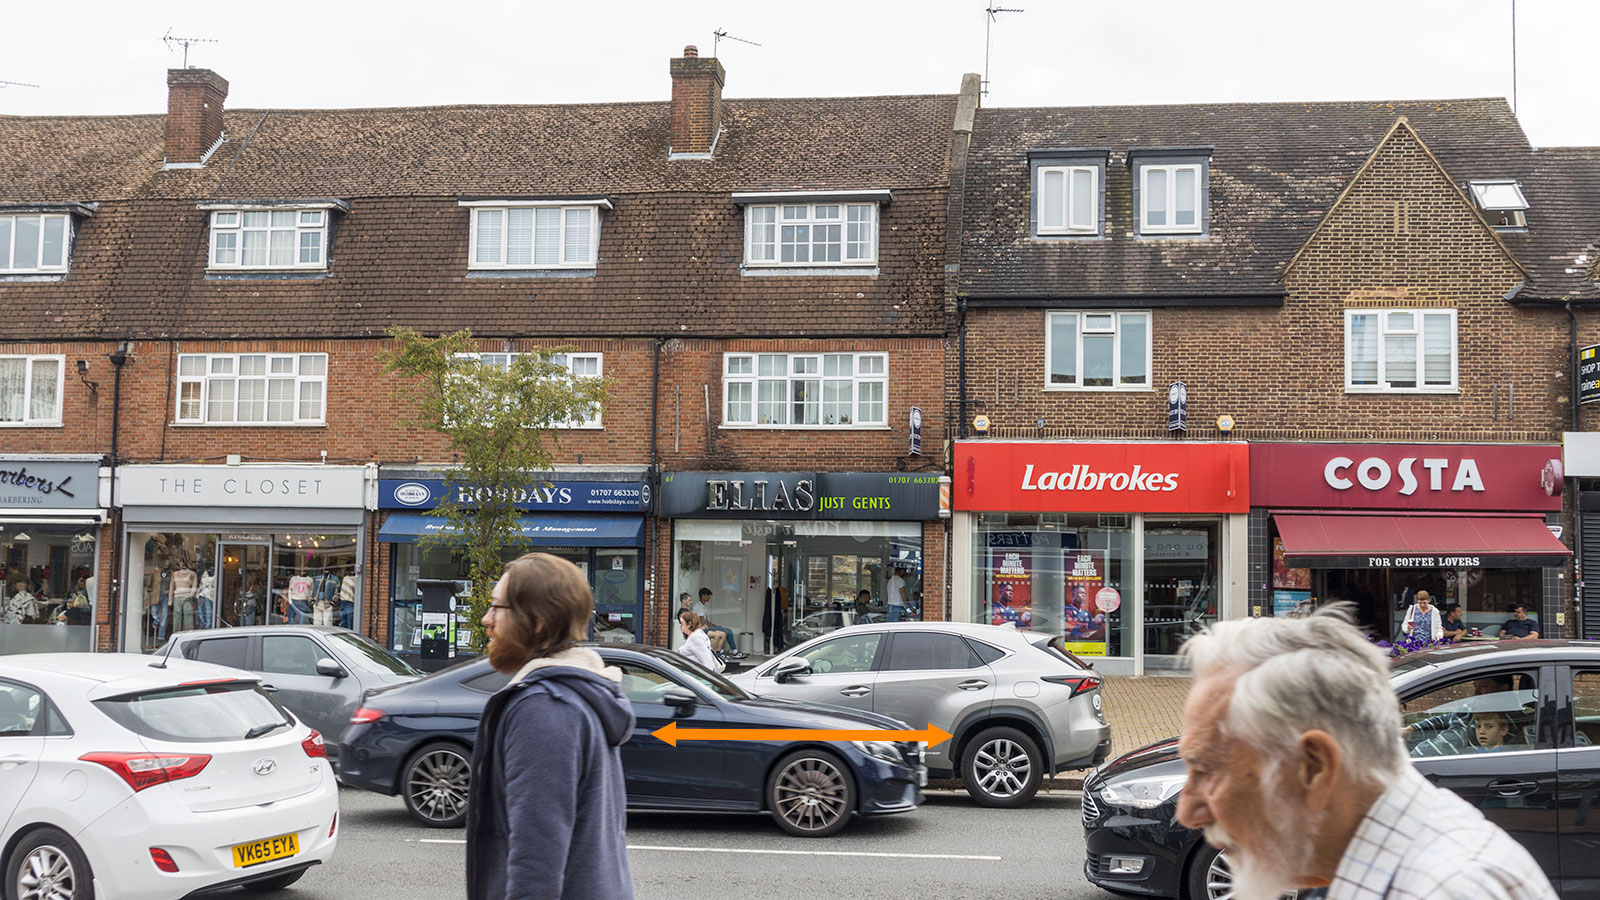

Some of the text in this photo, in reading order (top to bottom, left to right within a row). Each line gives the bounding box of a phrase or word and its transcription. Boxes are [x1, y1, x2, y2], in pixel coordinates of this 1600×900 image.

[1581, 363, 1596, 376] SHOP
[888, 476, 911, 484] 01707
[1020, 464, 1179, 492] Ladbrokes
[1323, 456, 1486, 496] COSTA
[159, 478, 323, 495] THE CLOSET
[590, 489, 612, 497] 01707
[613, 489, 640, 497] 663330
[706, 480, 814, 512] ELIAS
[818, 496, 891, 512] JUST GENTS
[1368, 557, 1480, 567] FOR COFFEE LOVERS
[237, 836, 296, 863] VK65 EYA
